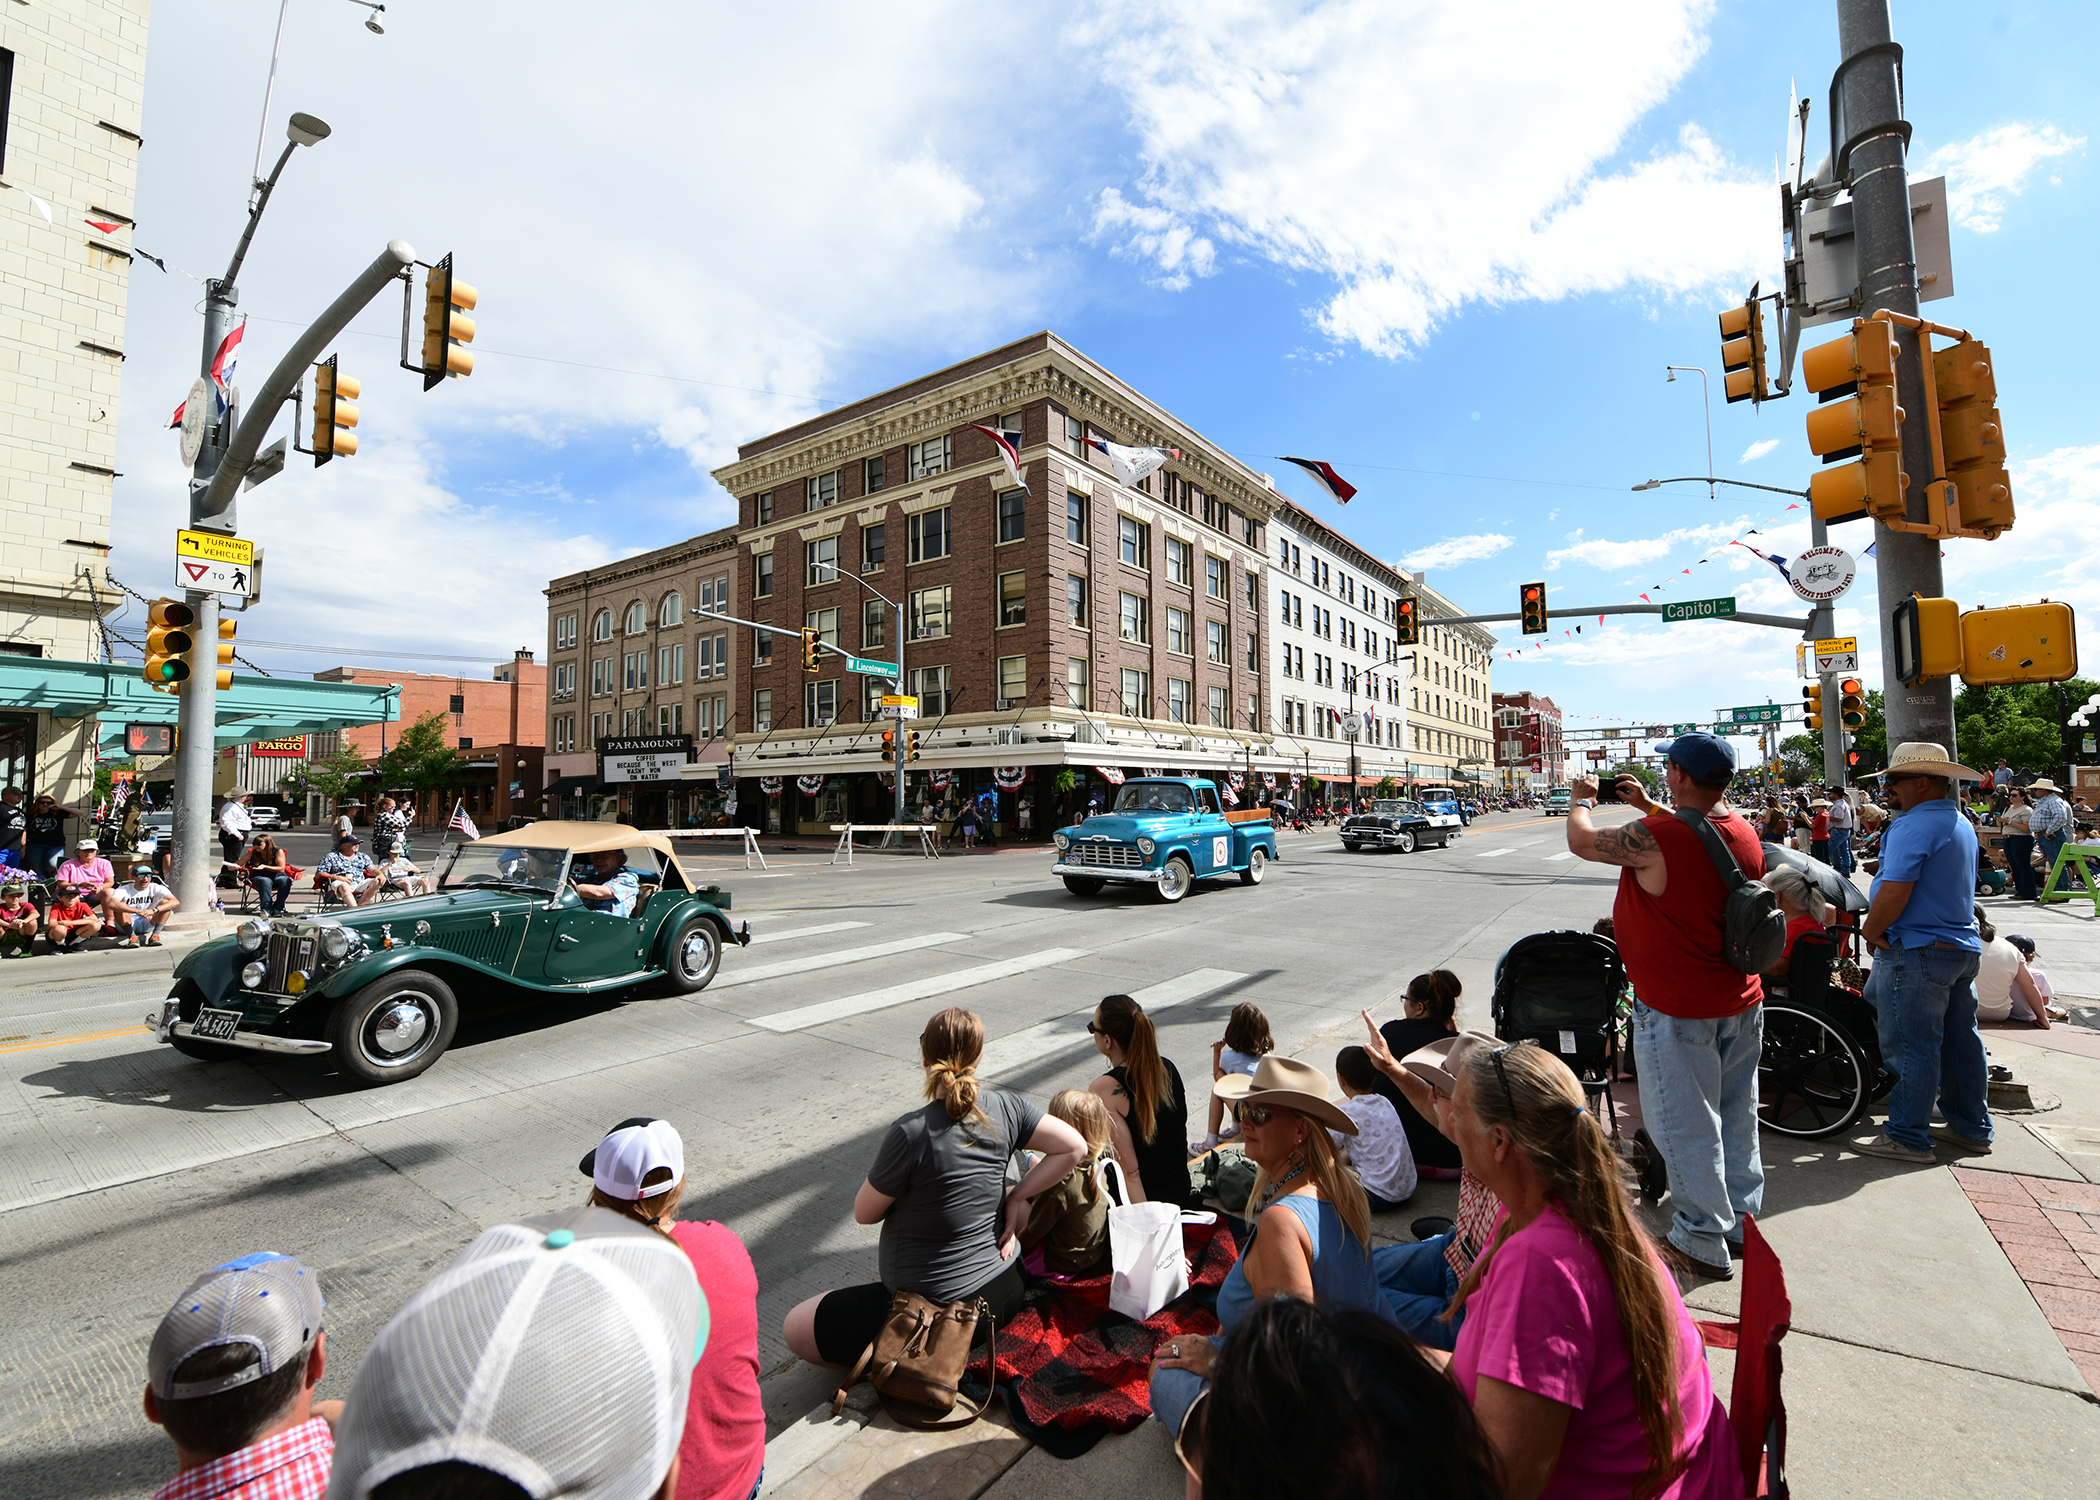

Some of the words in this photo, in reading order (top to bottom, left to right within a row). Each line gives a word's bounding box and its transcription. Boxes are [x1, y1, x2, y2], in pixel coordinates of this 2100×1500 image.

[205, 537, 248, 551] TURNING
[203, 547, 249, 561] VEHICLES
[1800, 547, 1834, 561] WELCOME
[1834, 549, 1844, 557] TO
[212, 572, 225, 580] TO
[1815, 585, 1845, 599] FRONTIER
[1667, 600, 1716, 620] Capitol
[848, 659, 854, 669] W
[856, 660, 888, 675] Lincolnway
[160, 729, 171, 749] 9
[257, 741, 303, 751] FARGO
[607, 739, 683, 750] PARAMOUNT
[617, 761, 641, 769] BECAUSE
[209, 1019, 235, 1036] 5427
